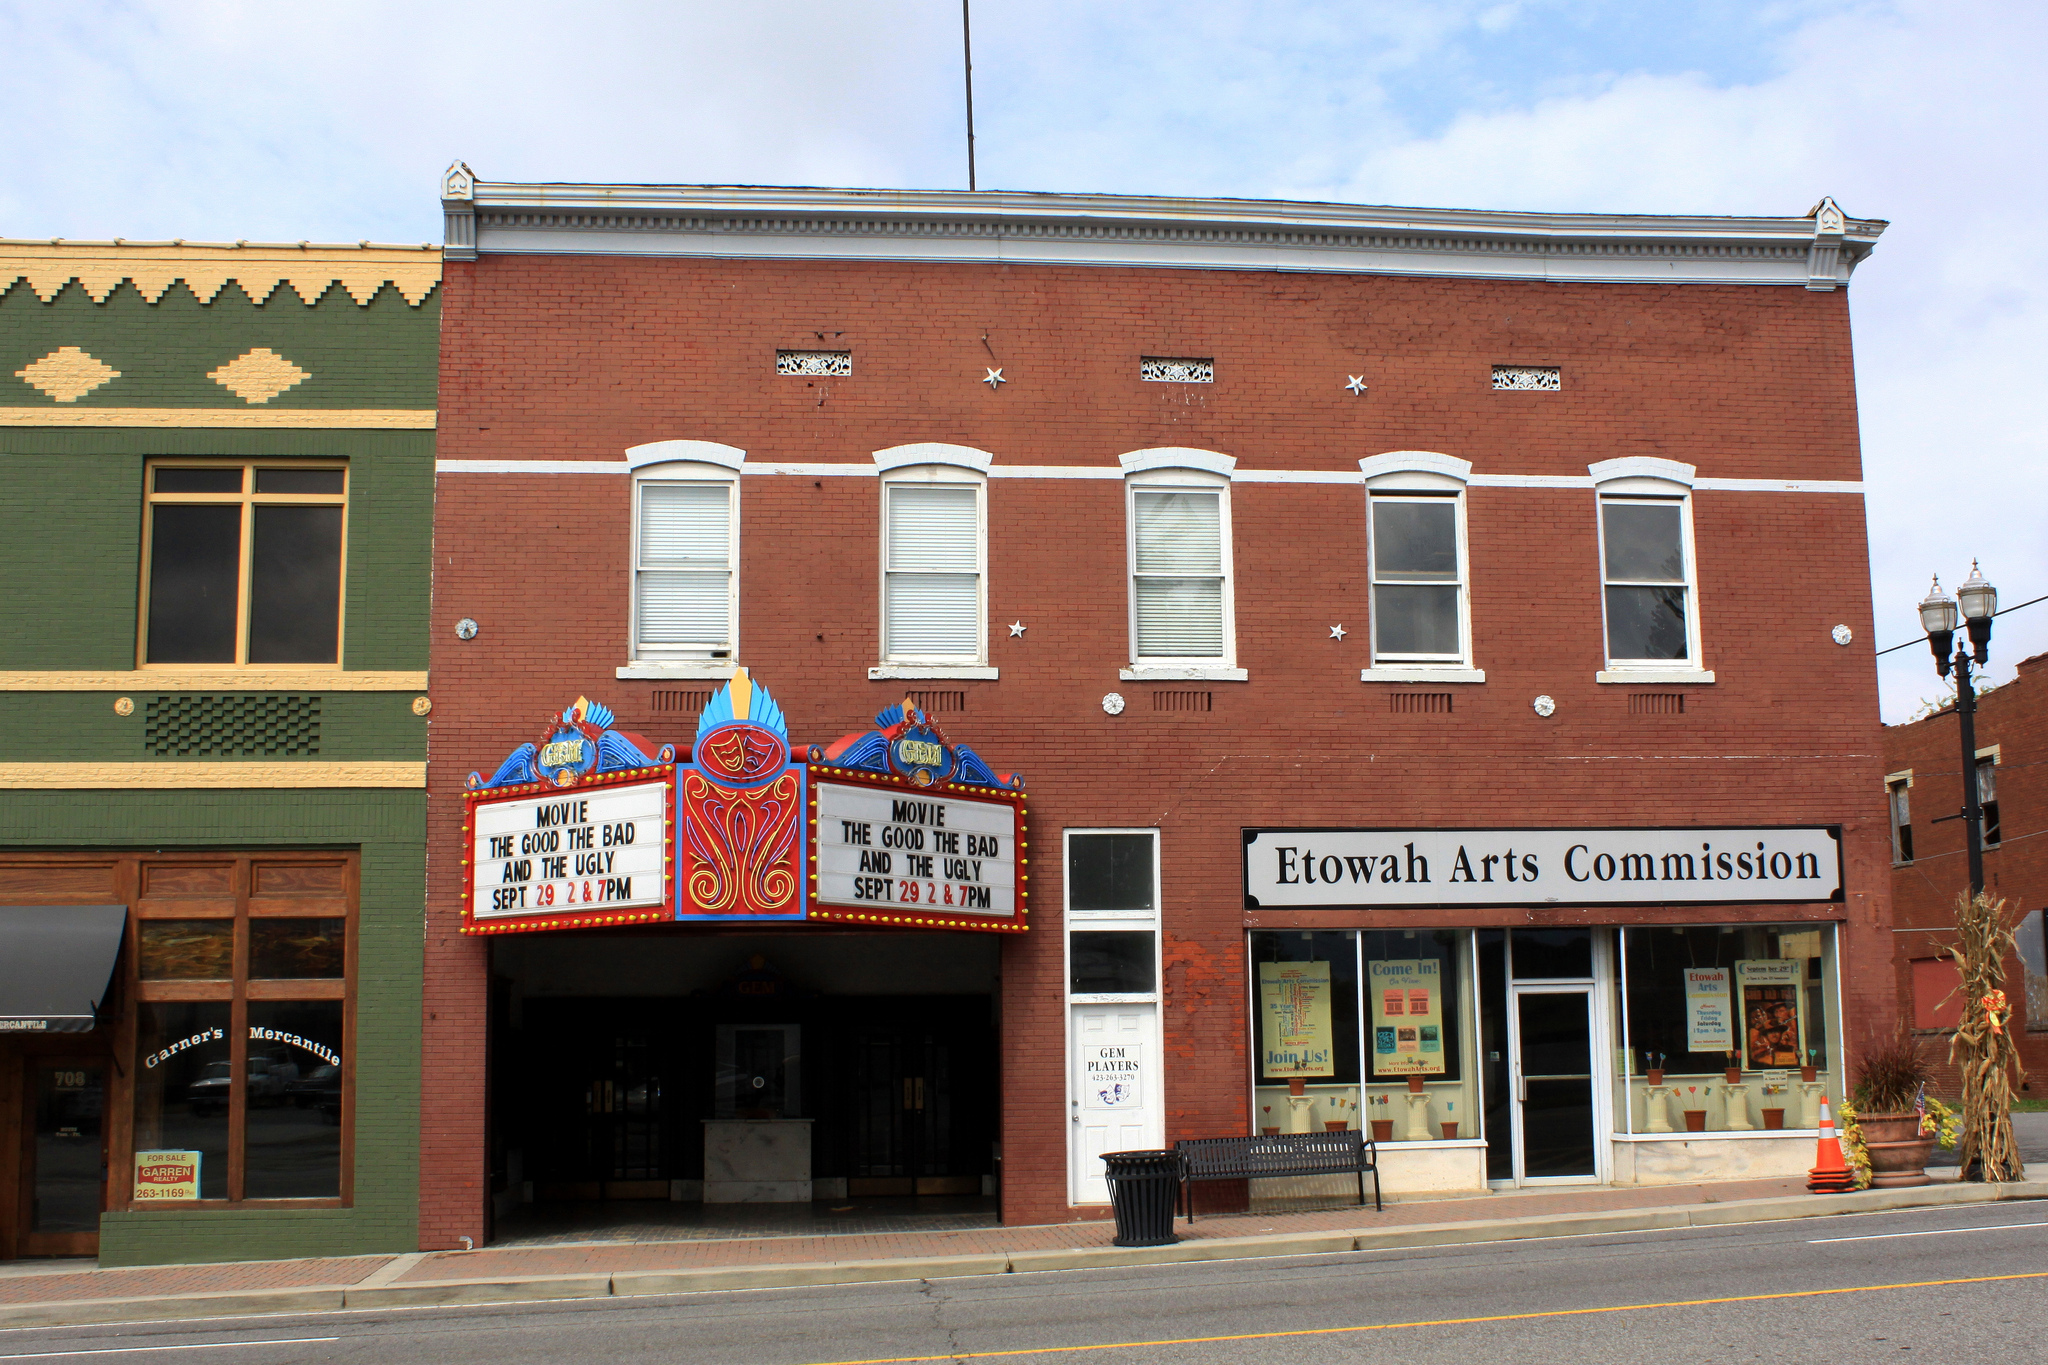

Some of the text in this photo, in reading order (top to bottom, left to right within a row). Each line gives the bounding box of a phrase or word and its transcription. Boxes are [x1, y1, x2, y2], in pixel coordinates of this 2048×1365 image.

[537, 801, 588, 828] MOVIE
[892, 800, 945, 827] MOVIE
[490, 822, 635, 858] THE GOOD THE BAD
[842, 821, 998, 857] THE GOOD THE BAD
[503, 851, 615, 883] AND THE UGLY
[859, 850, 981, 882] AND THE UGLY
[1275, 841, 1821, 885] Etowah Arts Commission
[493, 877, 631, 910] SEPT 29 2 & 7PM
[854, 877, 991, 908] SEPT 29 2 & 7PM
[1372, 962, 1438, 976] Come In!
[1690, 972, 1724, 981] Etowah
[738, 981, 777, 995] GEM
[1698, 983, 1718, 991] Arts
[145, 1027, 341, 1069] Garner's Mercantile
[1100, 1048, 1125, 1058] GEM
[1266, 1049, 1328, 1064] Join Us!
[1088, 1061, 1139, 1071] PLAYERS
[55, 1071, 86, 1087] 708
[1092, 1073, 1135, 1081] 423-263-3270
[142, 1167, 190, 1177] GARREN
[136, 1188, 184, 1198] 263-1169
